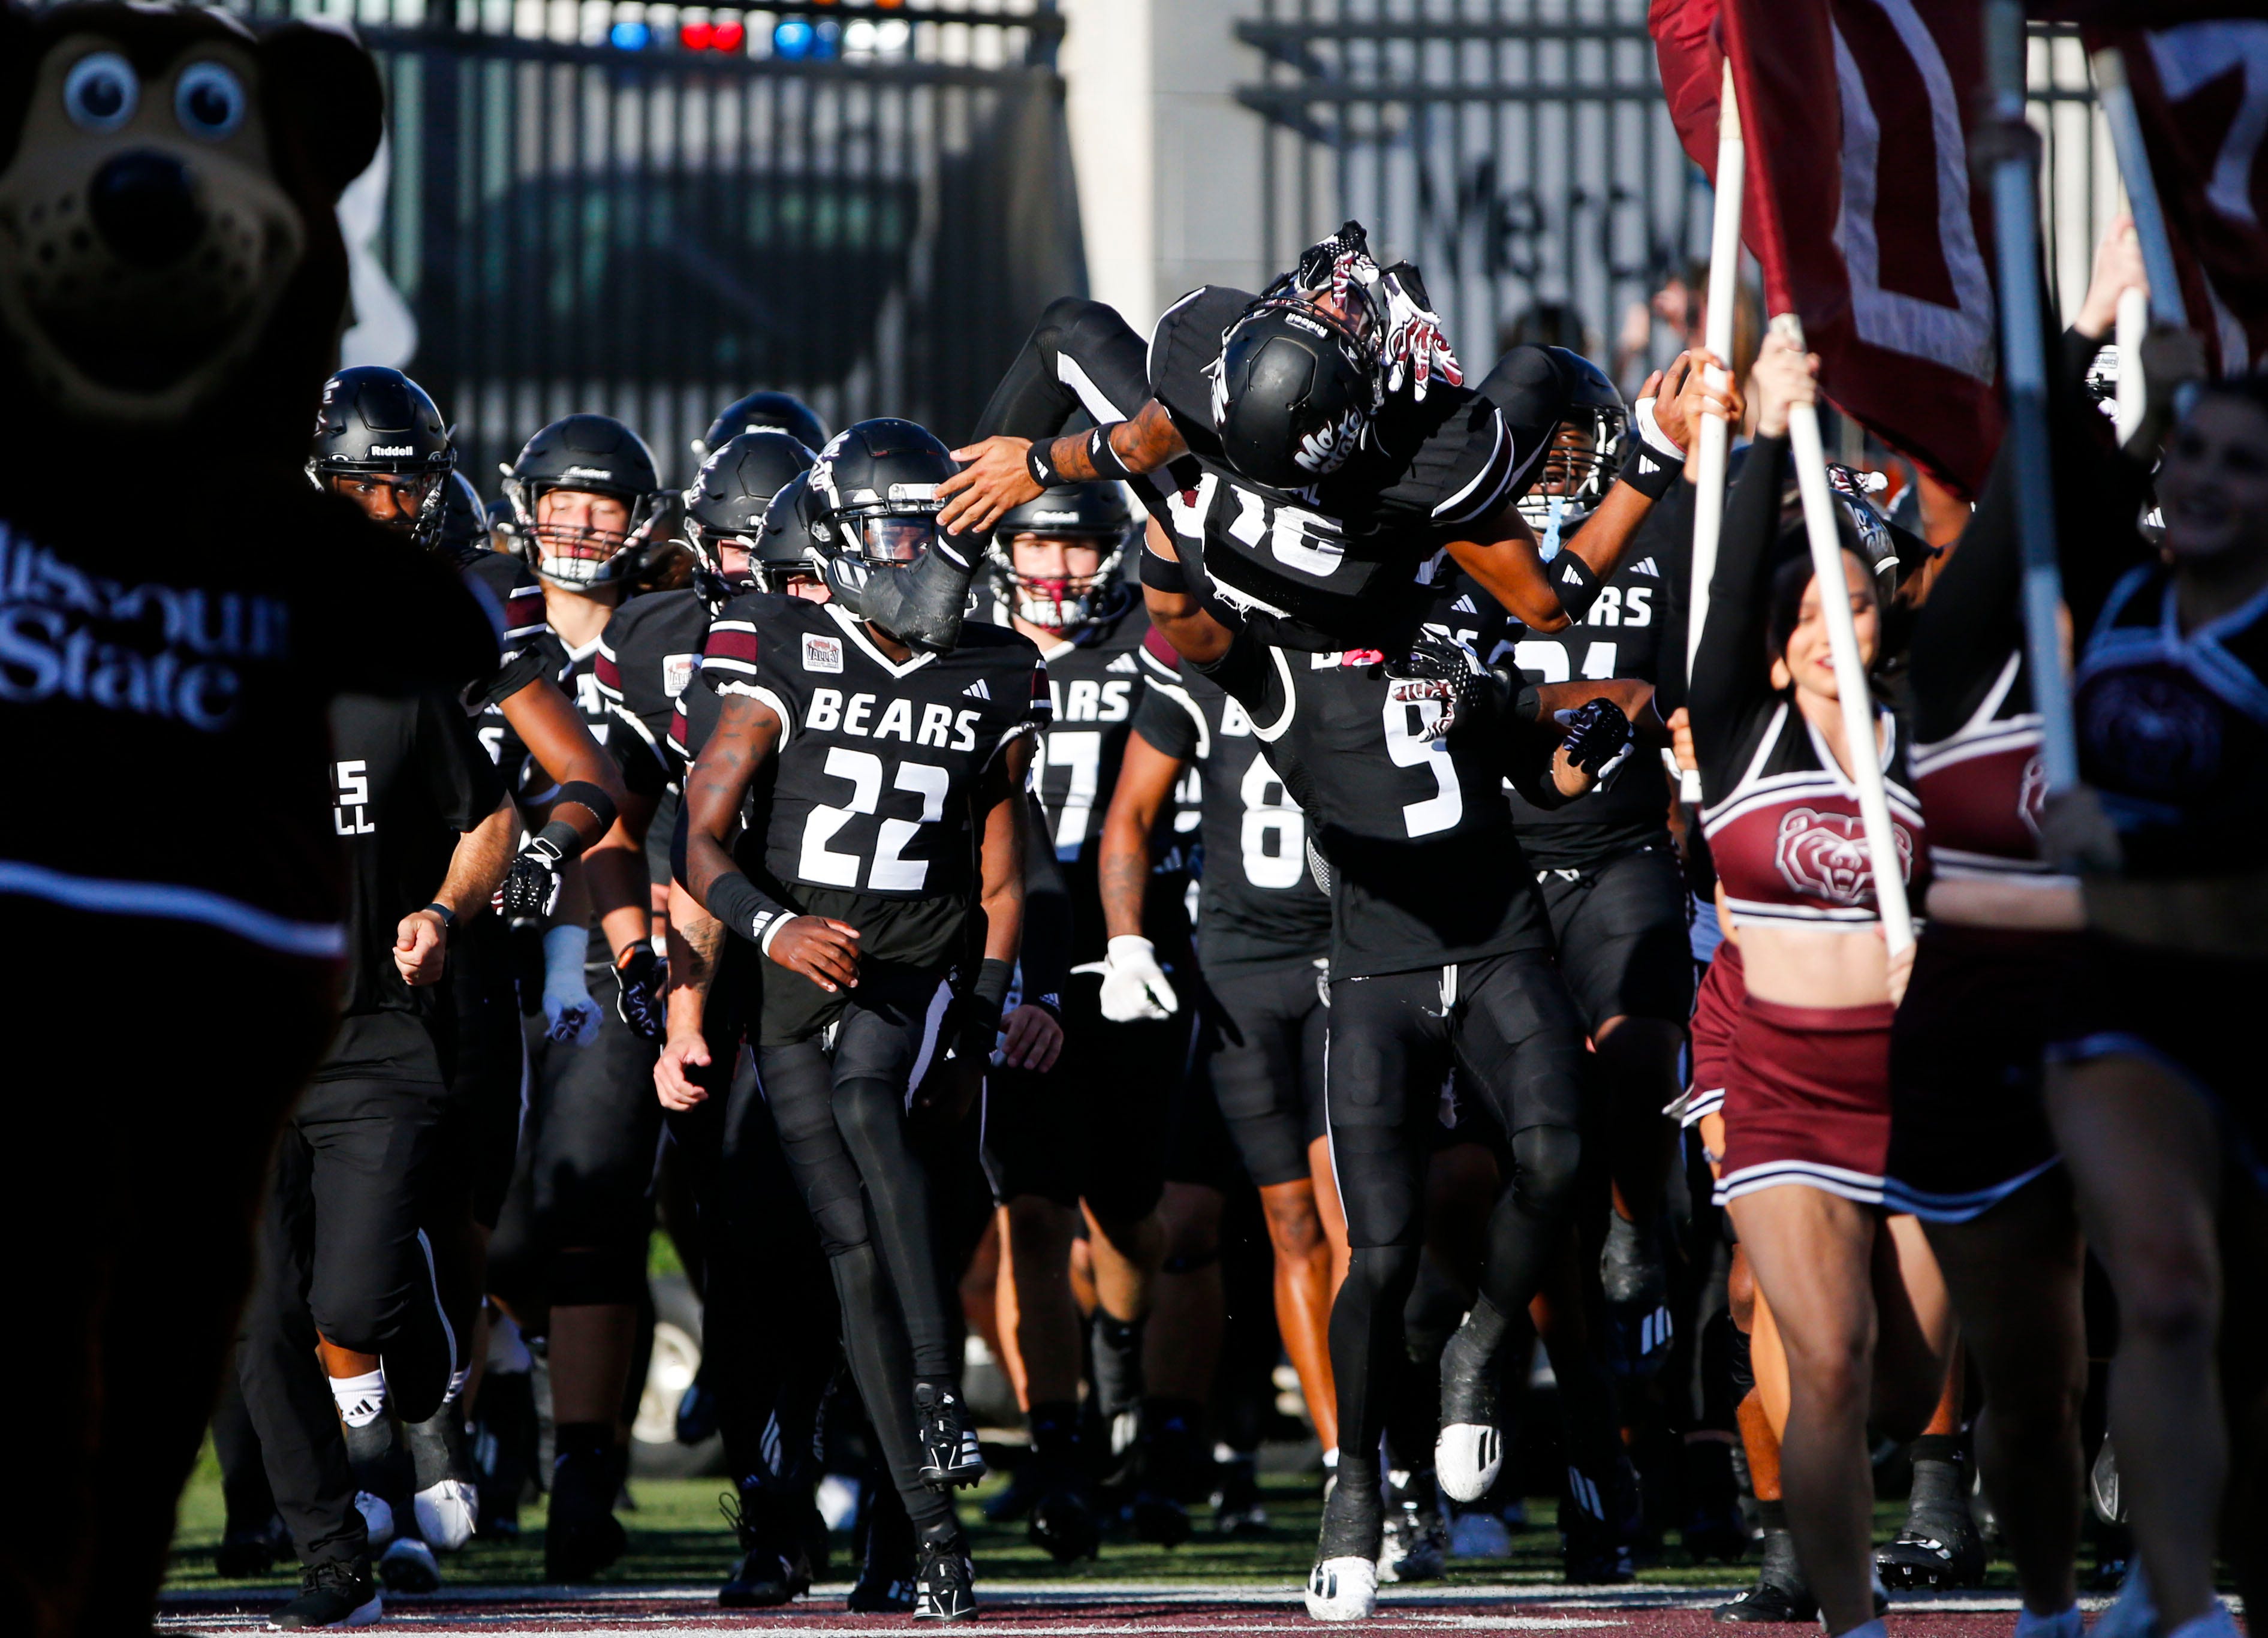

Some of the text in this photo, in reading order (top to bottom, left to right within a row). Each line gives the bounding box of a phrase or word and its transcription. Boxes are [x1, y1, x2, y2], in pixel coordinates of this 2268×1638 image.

[1285, 312, 1328, 338] Riddell
[371, 445, 414, 456] Riddell
[1294, 420, 1333, 472] Mo
[806, 644, 839, 663] VALLEY
[667, 670, 693, 685] VALL
[805, 688, 981, 752] BEARS
[1382, 679, 1463, 839] 9
[797, 746, 950, 890] 22
